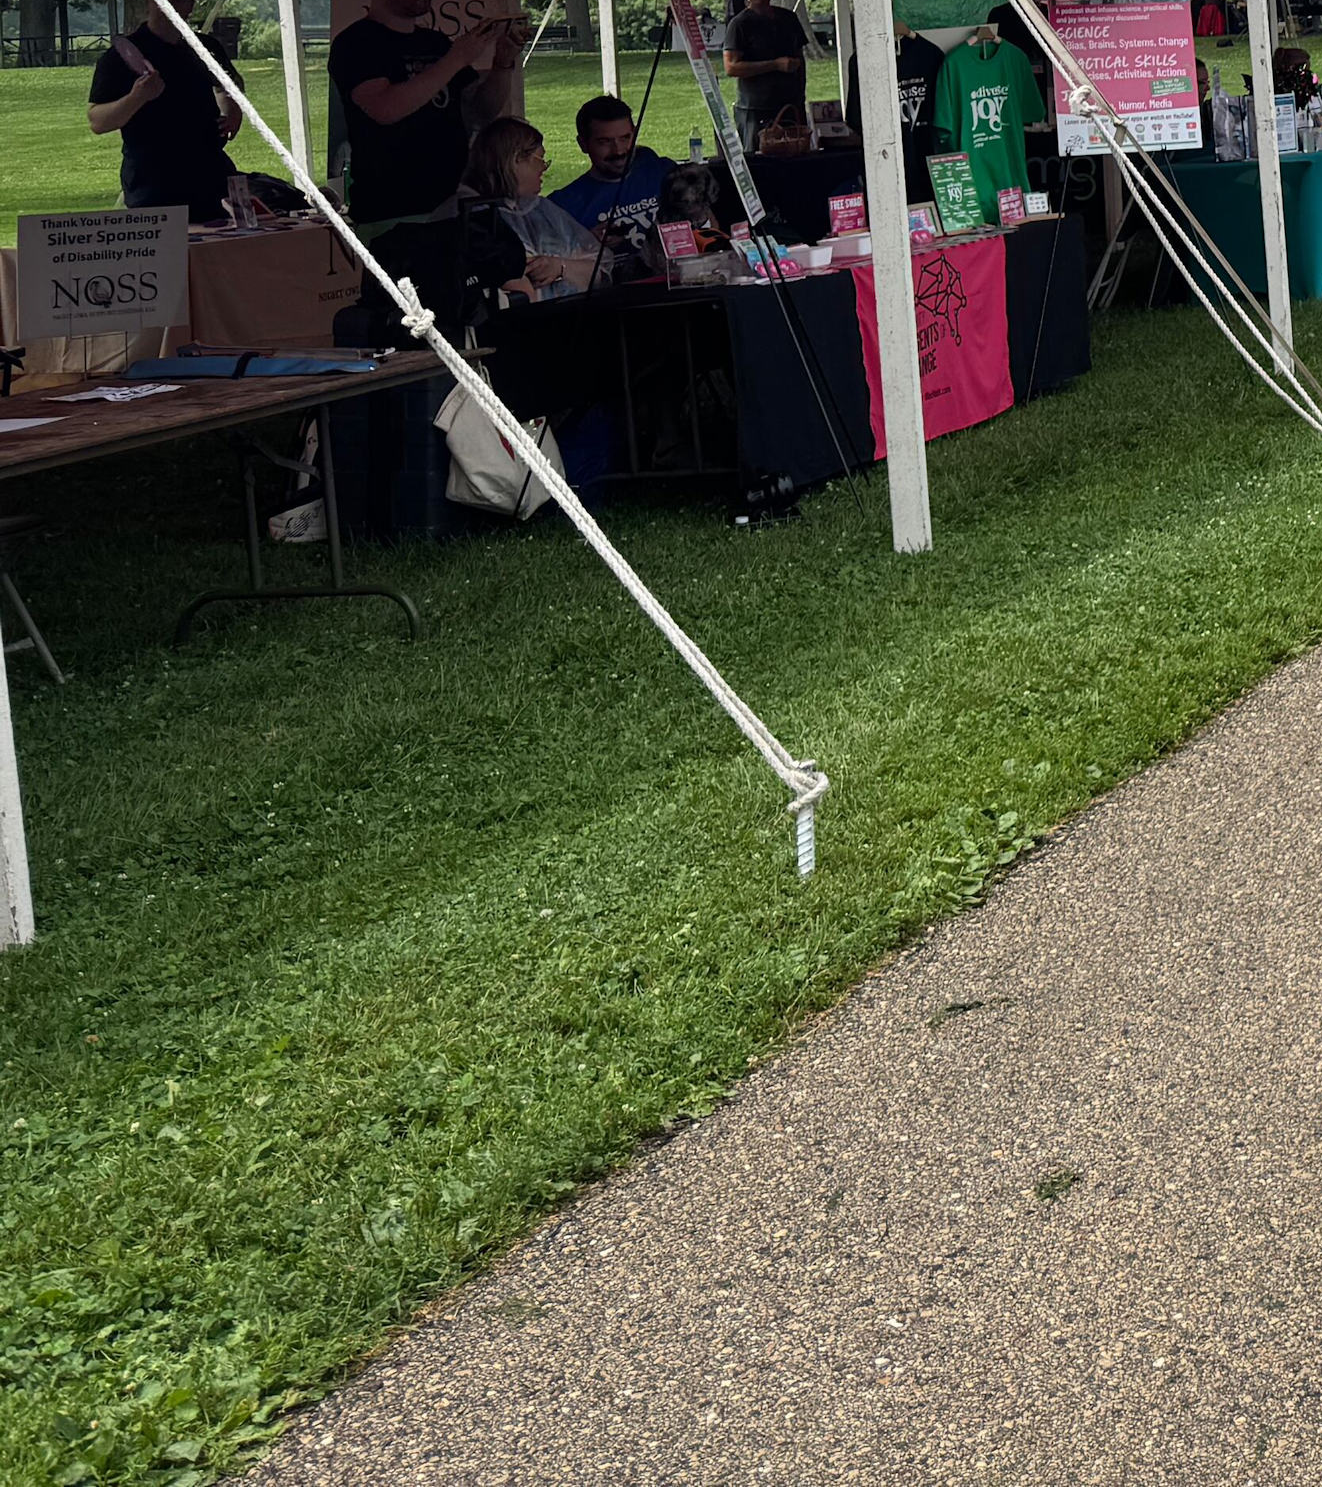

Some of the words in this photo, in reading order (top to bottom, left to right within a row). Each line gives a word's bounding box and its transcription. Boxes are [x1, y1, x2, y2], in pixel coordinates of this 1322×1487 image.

[1061, 8, 1084, 16] podcast
[1143, 4, 1168, 13] practical
[1090, 15, 1114, 24] diversity
[1056, 26, 1110, 39] SCIENCE
[1066, 40, 1087, 51] Bias,
[1088, 39, 1117, 50] Brains,
[1119, 38, 1157, 50] Systems,
[1158, 36, 1189, 48] Change
[1060, 54, 1129, 71] ACTICAL
[1134, 53, 1178, 67] SKILLS
[1089, 70, 1112, 81] cises,
[1113, 69, 1154, 80] Activities,
[1156, 67, 1187, 78] Actions
[1119, 101, 1148, 111] Humor,
[1149, 100, 1173, 109] Media
[41, 218, 78, 230] Thank
[80, 217, 101, 227] You
[104, 215, 122, 226] For
[125, 214, 159, 226] Being
[161, 214, 168, 222] a
[47, 231, 93, 247] Silver
[96, 228, 162, 245] Sponsor
[52, 252, 65, 263] of
[67, 249, 123, 264] Disability
[125, 246, 156, 259] Pride
[51, 271, 158, 309] NOSS
